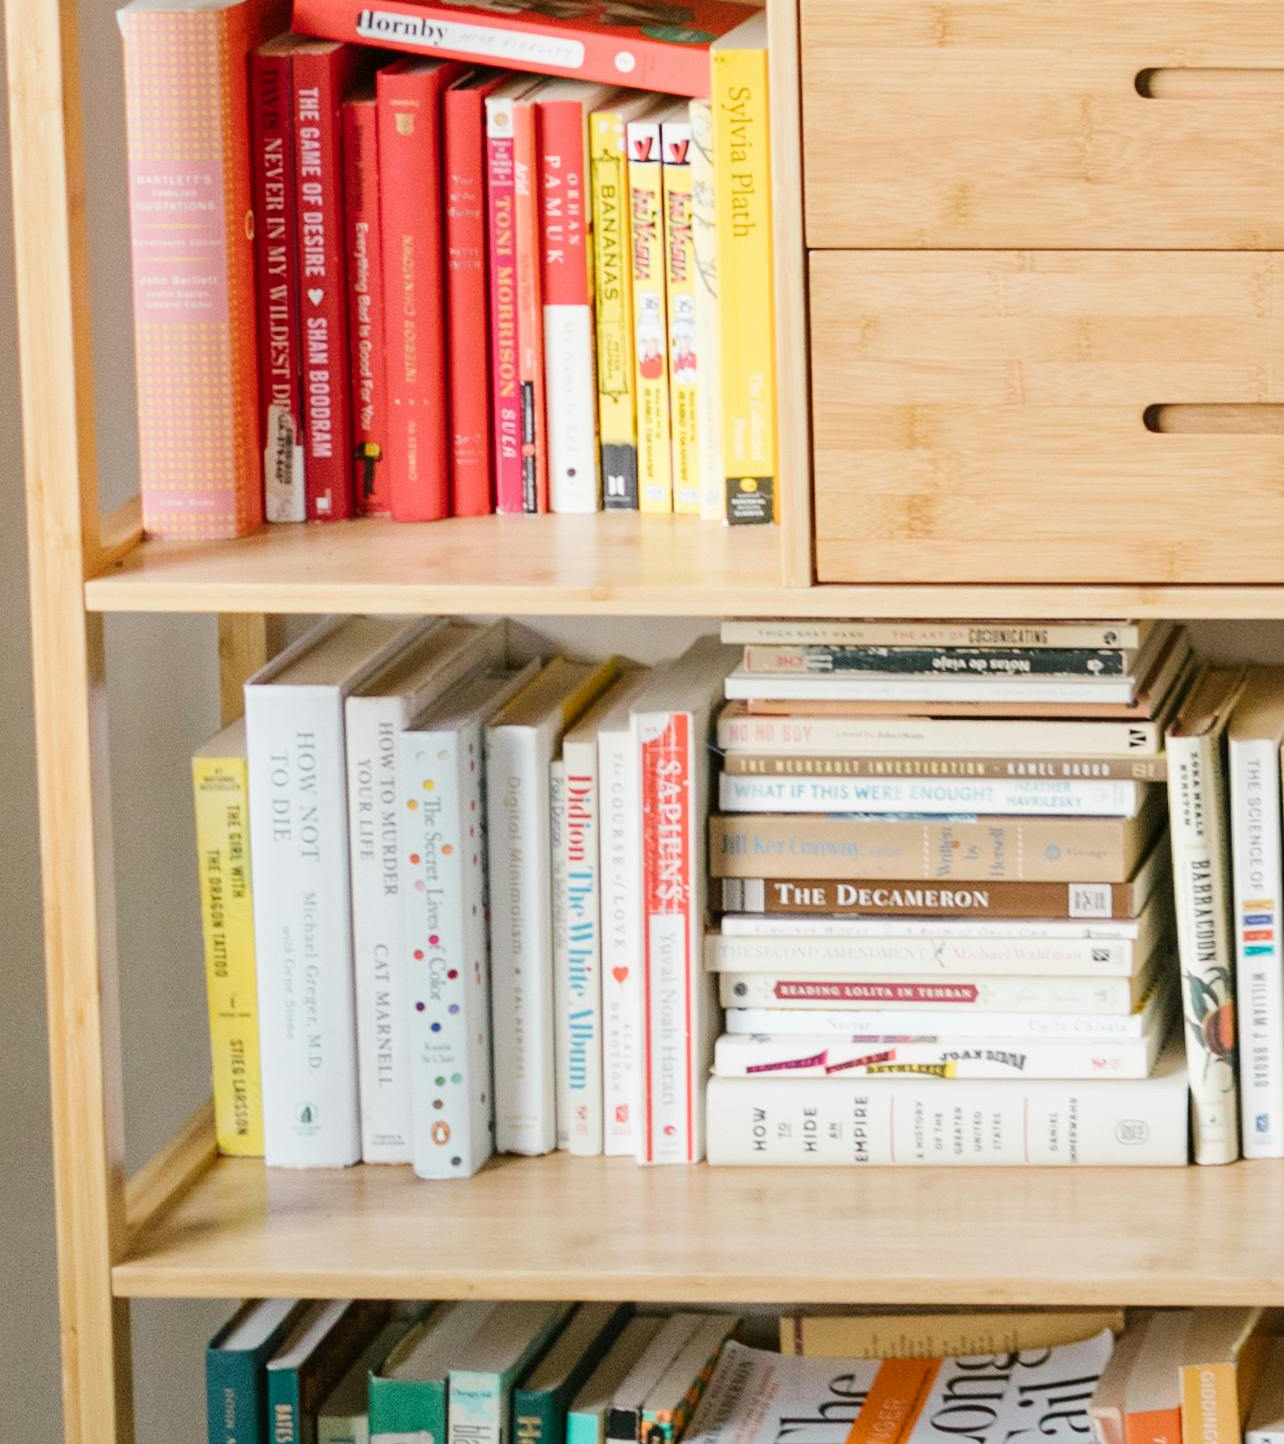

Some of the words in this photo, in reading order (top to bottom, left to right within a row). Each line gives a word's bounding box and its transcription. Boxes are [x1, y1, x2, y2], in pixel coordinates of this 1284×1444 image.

[298, 88, 319, 122] THE
[726, 85, 752, 163] Sylvia
[262, 138, 283, 209] NEVER
[299, 127, 321, 177] GAME
[301, 182, 322, 207] OF
[545, 155, 563, 264] PAMUK
[731, 173, 754, 237] Plath
[266, 217, 285, 239] IN
[302, 212, 325, 277] DESIRE
[495, 195, 512, 256] TONI
[600, 184, 620, 300] BANANAS
[266, 245, 286, 278] MY
[353, 223, 369, 292] Everything
[267, 284, 289, 379] WILDEST
[358, 295, 371, 320] Bad
[359, 325, 370, 337] Is
[496, 265, 515, 398] MORRISON
[306, 318, 329, 364] SHAN
[357, 340, 371, 374] Good
[308, 370, 331, 457] BOODRAM
[358, 379, 372, 401] For
[359, 405, 374, 430] You
[500, 408, 516, 458] SULA
[270, 751, 289, 786] TO
[295, 732, 315, 796] HOW
[377, 721, 394, 771] HOW
[357, 759, 373, 812] YOUR
[379, 781, 395, 804] TO
[1246, 760, 1261, 792] THE
[272, 799, 291, 842] DIE
[298, 806, 318, 862] NOT
[359, 821, 374, 862] LIFE
[566, 775, 593, 862] Didion
[656, 760, 682, 904] SAPIENS
[1248, 797, 1263, 864] SCIENCE
[379, 812, 398, 896] MURDER
[567, 866, 593, 916] The
[775, 882, 826, 905] THE
[837, 883, 989, 907] DECAMERON
[1249, 870, 1264, 891] OF
[1190, 859, 1216, 962] BARRACOON
[373, 943, 389, 983] CAT
[567, 922, 593, 998] White
[229, 1039, 245, 1074] STIEG
[374, 992, 393, 1087] MARNELL
[568, 1002, 594, 1090] Album
[231, 1078, 249, 1135] LARSSON
[753, 1106, 766, 1152] HOW
[803, 1106, 817, 1154] HIDE
[854, 1095, 869, 1162] EMPIRE
